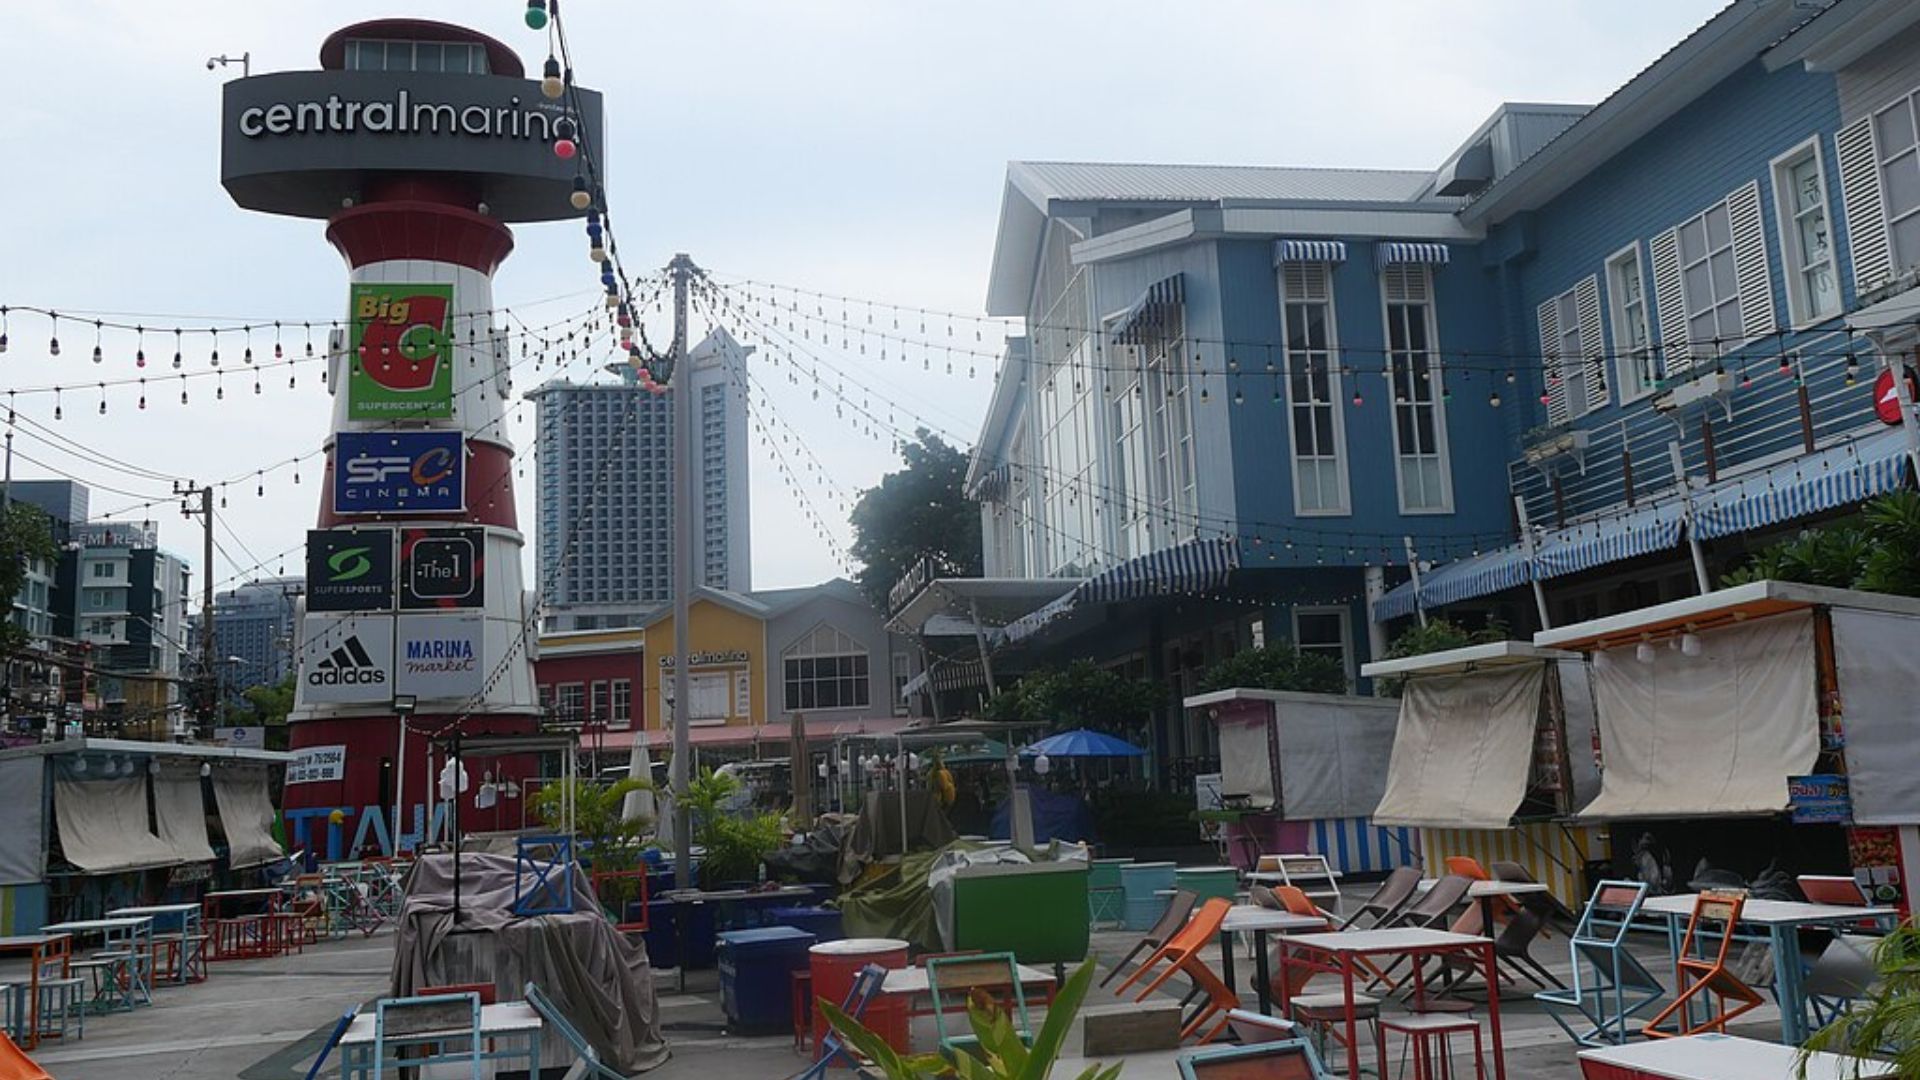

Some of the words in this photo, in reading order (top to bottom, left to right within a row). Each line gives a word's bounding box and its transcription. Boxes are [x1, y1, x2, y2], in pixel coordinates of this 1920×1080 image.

[239, 90, 580, 145] centralmarina
[358, 294, 410, 324] Big
[346, 487, 449, 498] CINEMA
[421, 561, 451, 578] The
[314, 585, 383, 594] SUPERSPORTS
[407, 640, 473, 658] MARINA
[405, 658, 476, 674] market
[309, 667, 385, 686] adidas
